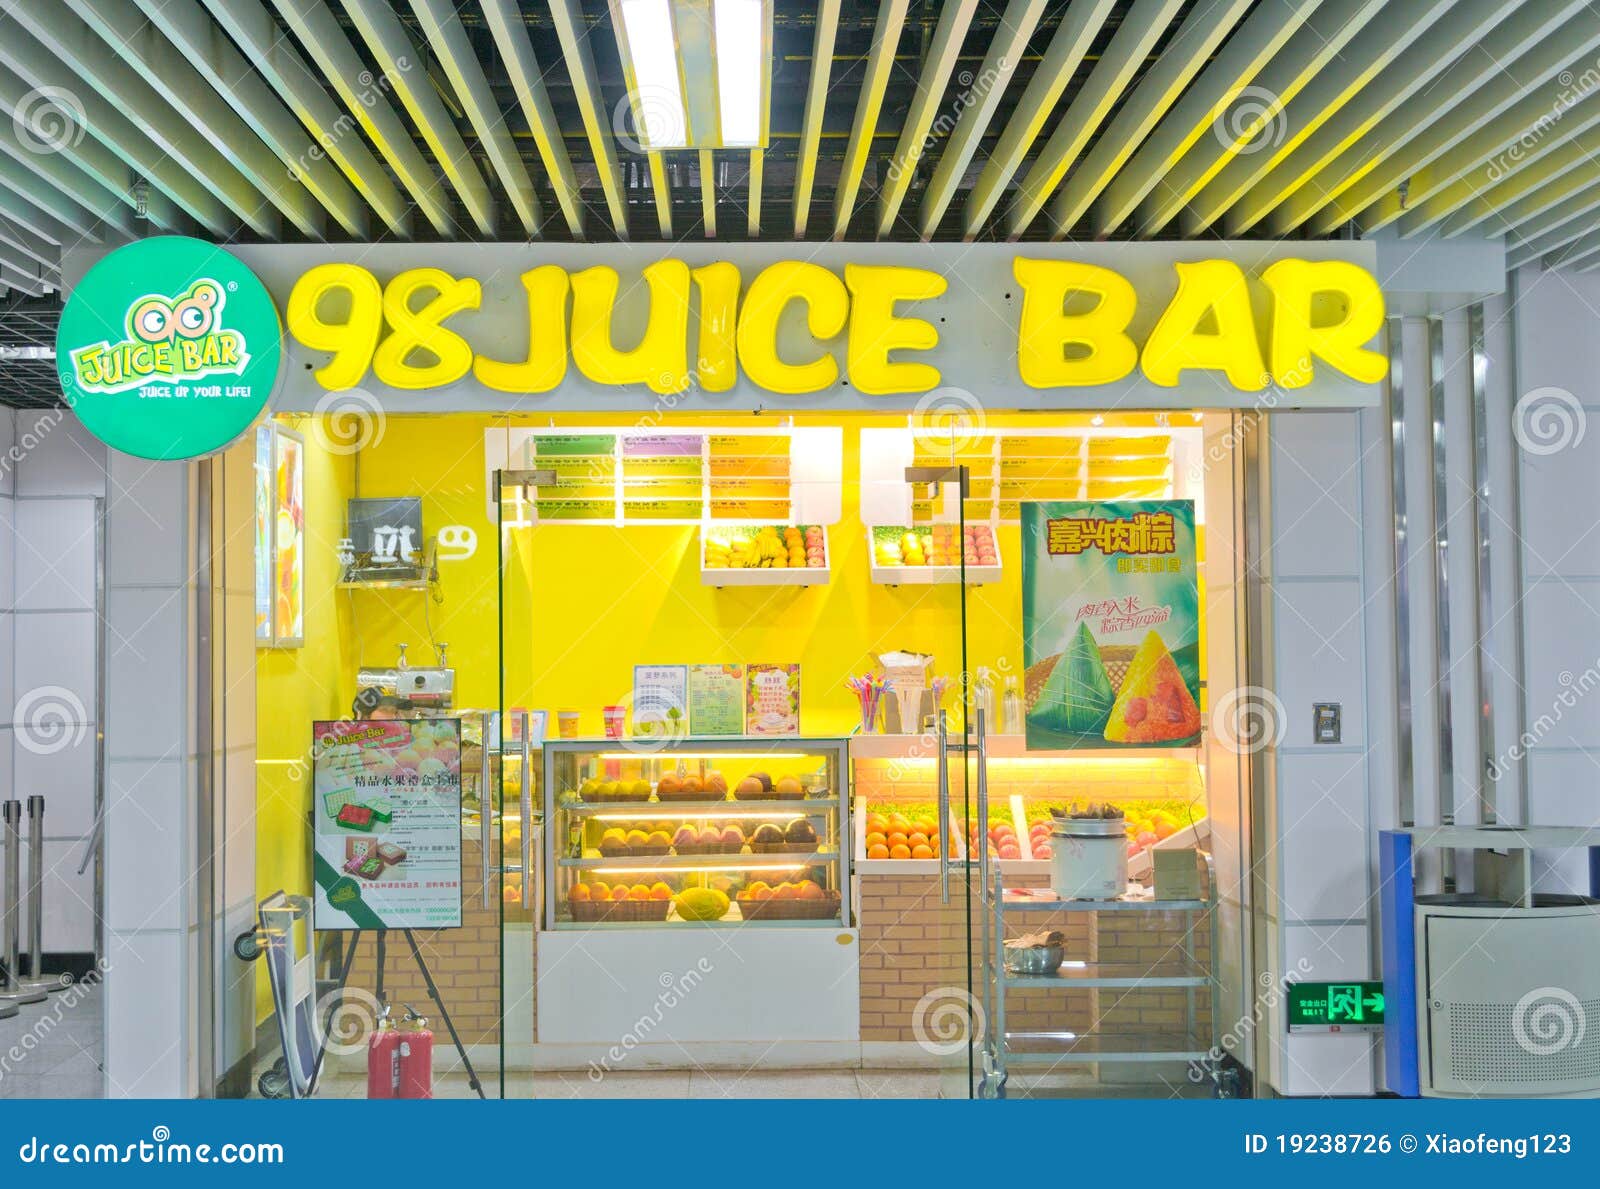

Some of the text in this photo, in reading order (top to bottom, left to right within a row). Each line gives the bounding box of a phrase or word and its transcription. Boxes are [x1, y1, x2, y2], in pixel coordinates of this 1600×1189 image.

[1013, 256, 1389, 391] BAR
[80, 334, 241, 385] JUICE BAR
[138, 386, 251, 398] JUICE UP YOUR LIFE!
[1047, 512, 1175, 555] 嘉兴肉粽
[366, 727, 385, 738] Bar
[1299, 999, 1327, 1007] 安全出口
[1302, 1008, 1324, 1016] EXIT
